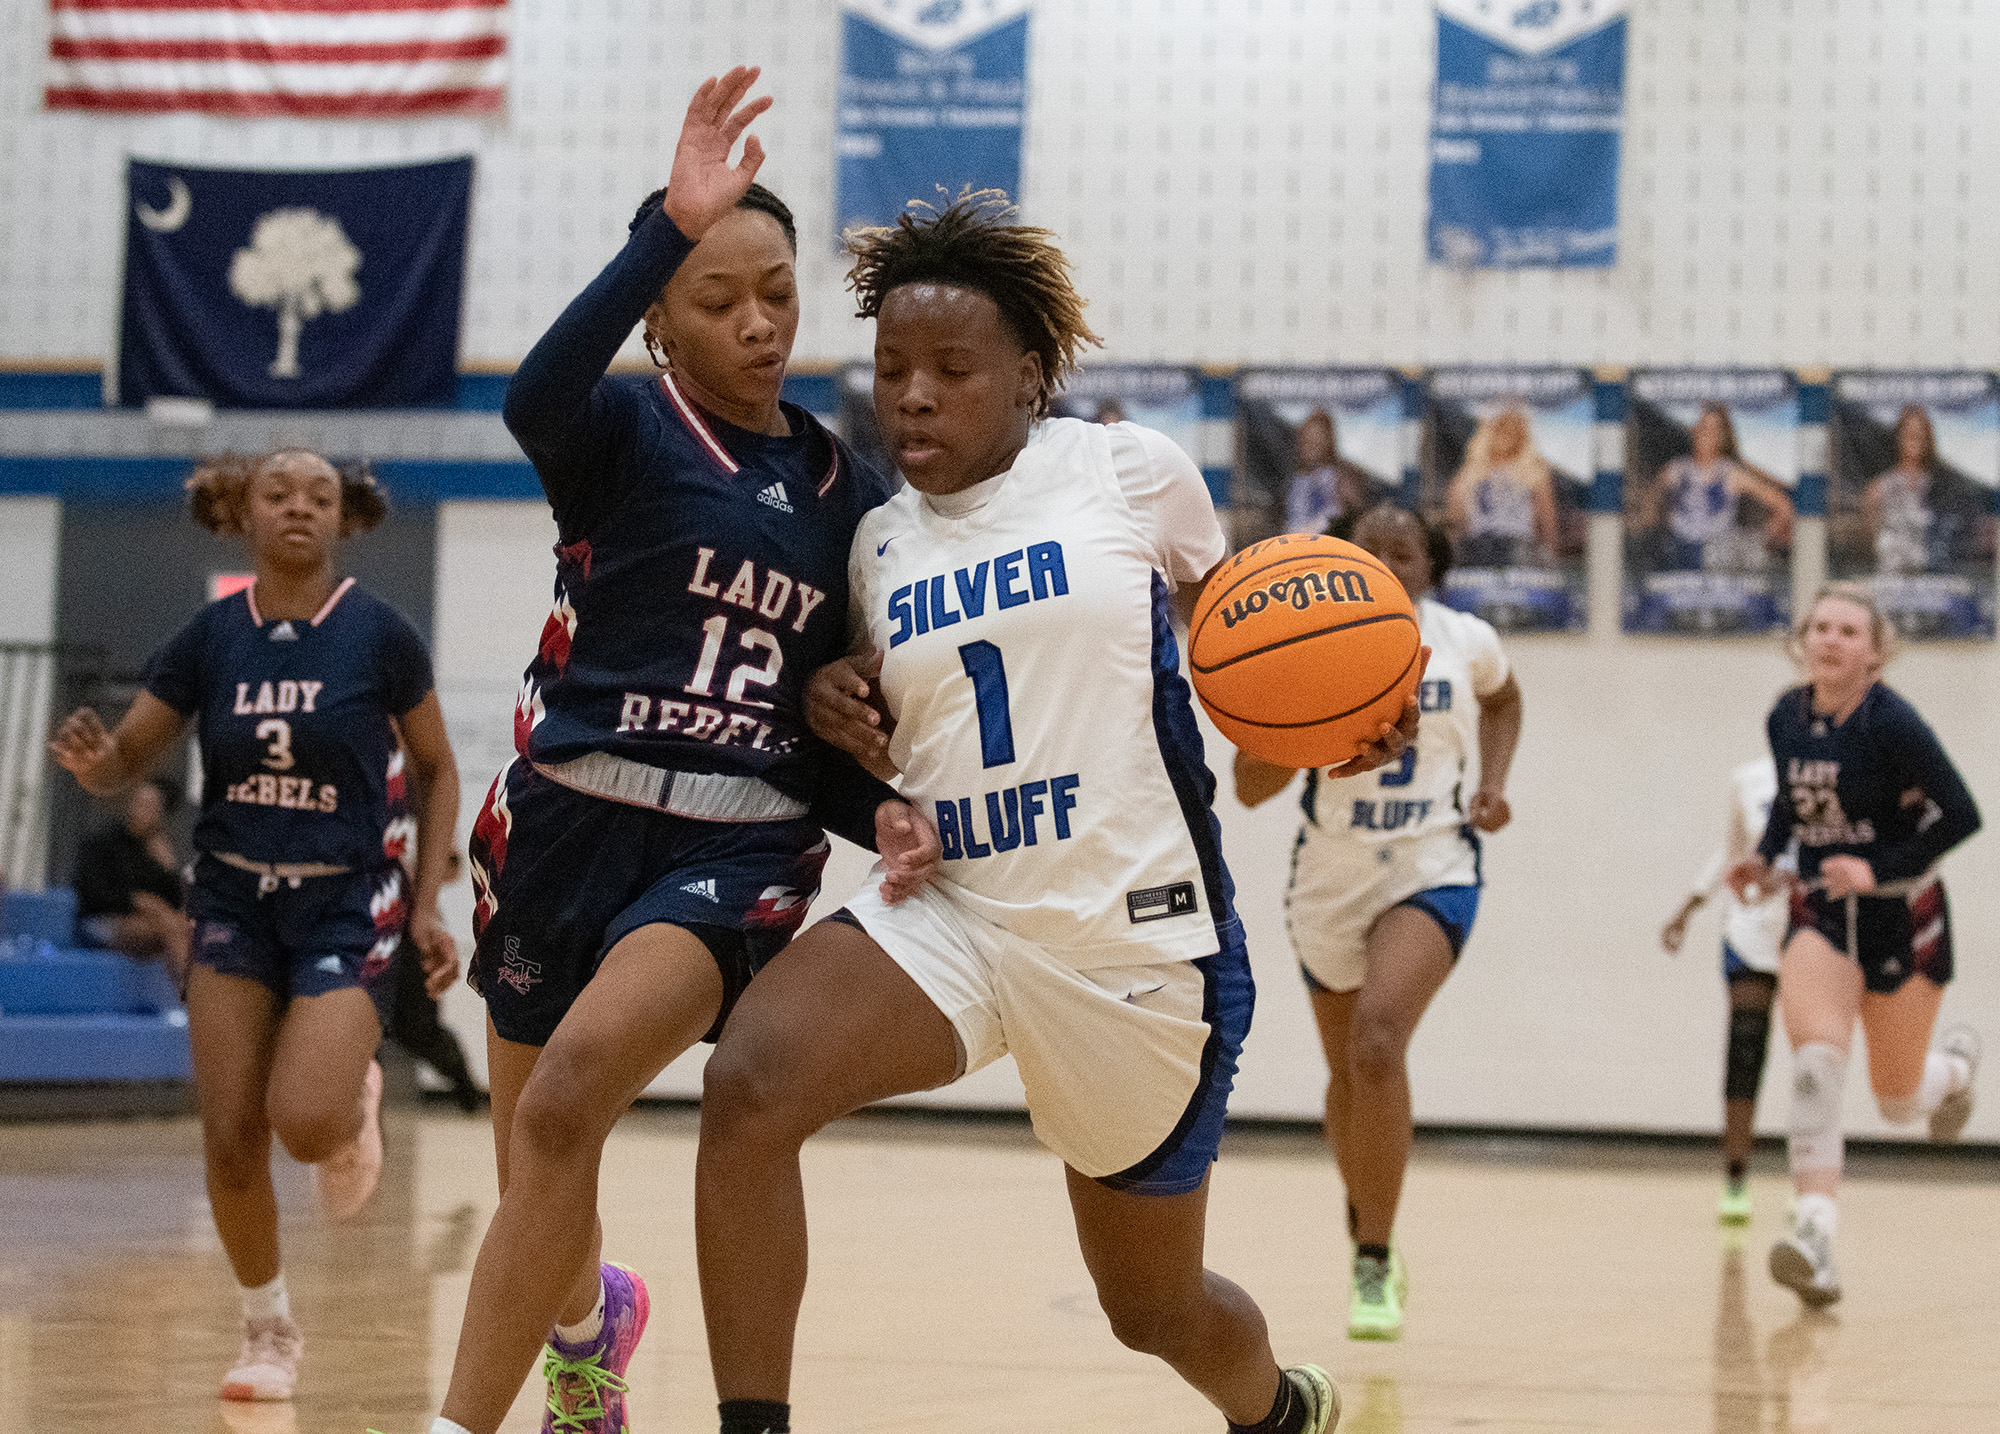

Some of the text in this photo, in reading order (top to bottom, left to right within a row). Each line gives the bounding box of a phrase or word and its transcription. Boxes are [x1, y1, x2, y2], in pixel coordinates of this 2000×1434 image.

[756, 492, 794, 514] adidas
[688, 547, 826, 633] LADY
[887, 540, 1070, 650] SILVER
[1220, 569, 1375, 629] Wilson
[683, 615, 784, 710] 12
[233, 680, 324, 715] LADY
[616, 692, 799, 754] REBEL
[957, 638, 1016, 770] 1
[255, 719, 296, 771] 3
[935, 773, 1081, 861] BLUFF
[1175, 892, 1187, 906] M
